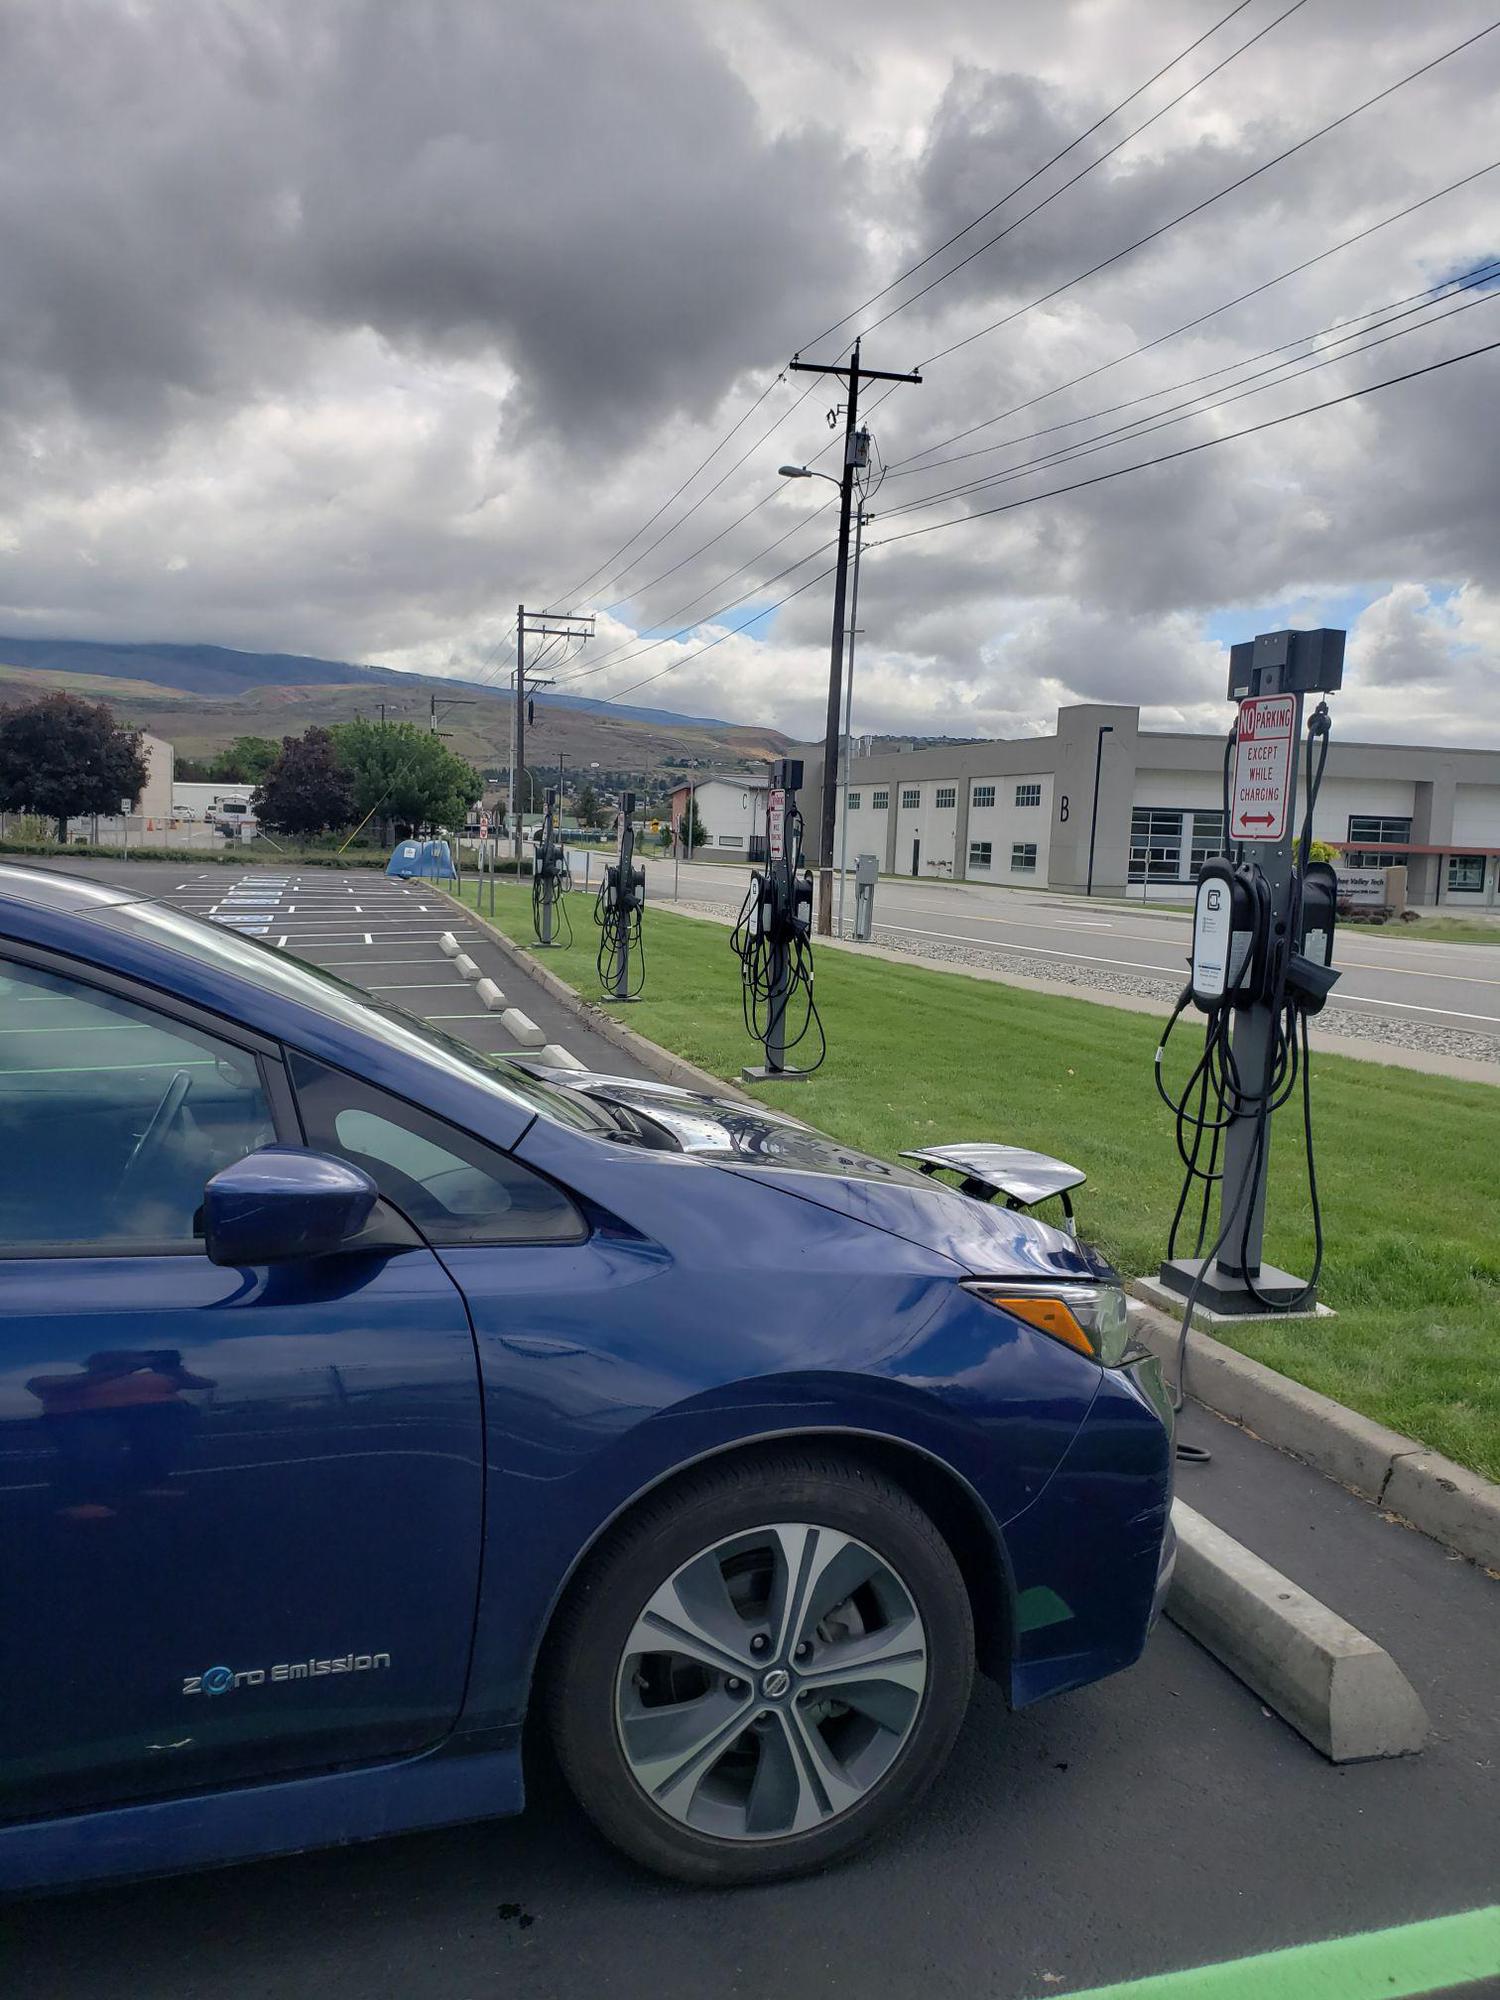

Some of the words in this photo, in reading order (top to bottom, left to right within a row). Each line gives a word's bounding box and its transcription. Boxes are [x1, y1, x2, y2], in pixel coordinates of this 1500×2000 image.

[1240, 707, 1255, 735] NO
[1256, 708, 1291, 730] PARKING
[1247, 746, 1278, 761] EXCEPT
[1249, 767, 1273, 781] WHILE
[742, 793, 748, 810] C
[1240, 788, 1279, 801] CHARGING
[1060, 795, 1069, 822] B
[1350, 878, 1369, 886] Valley
[1370, 878, 1384, 886] Tech
[271, 1653, 391, 1683] Emission
